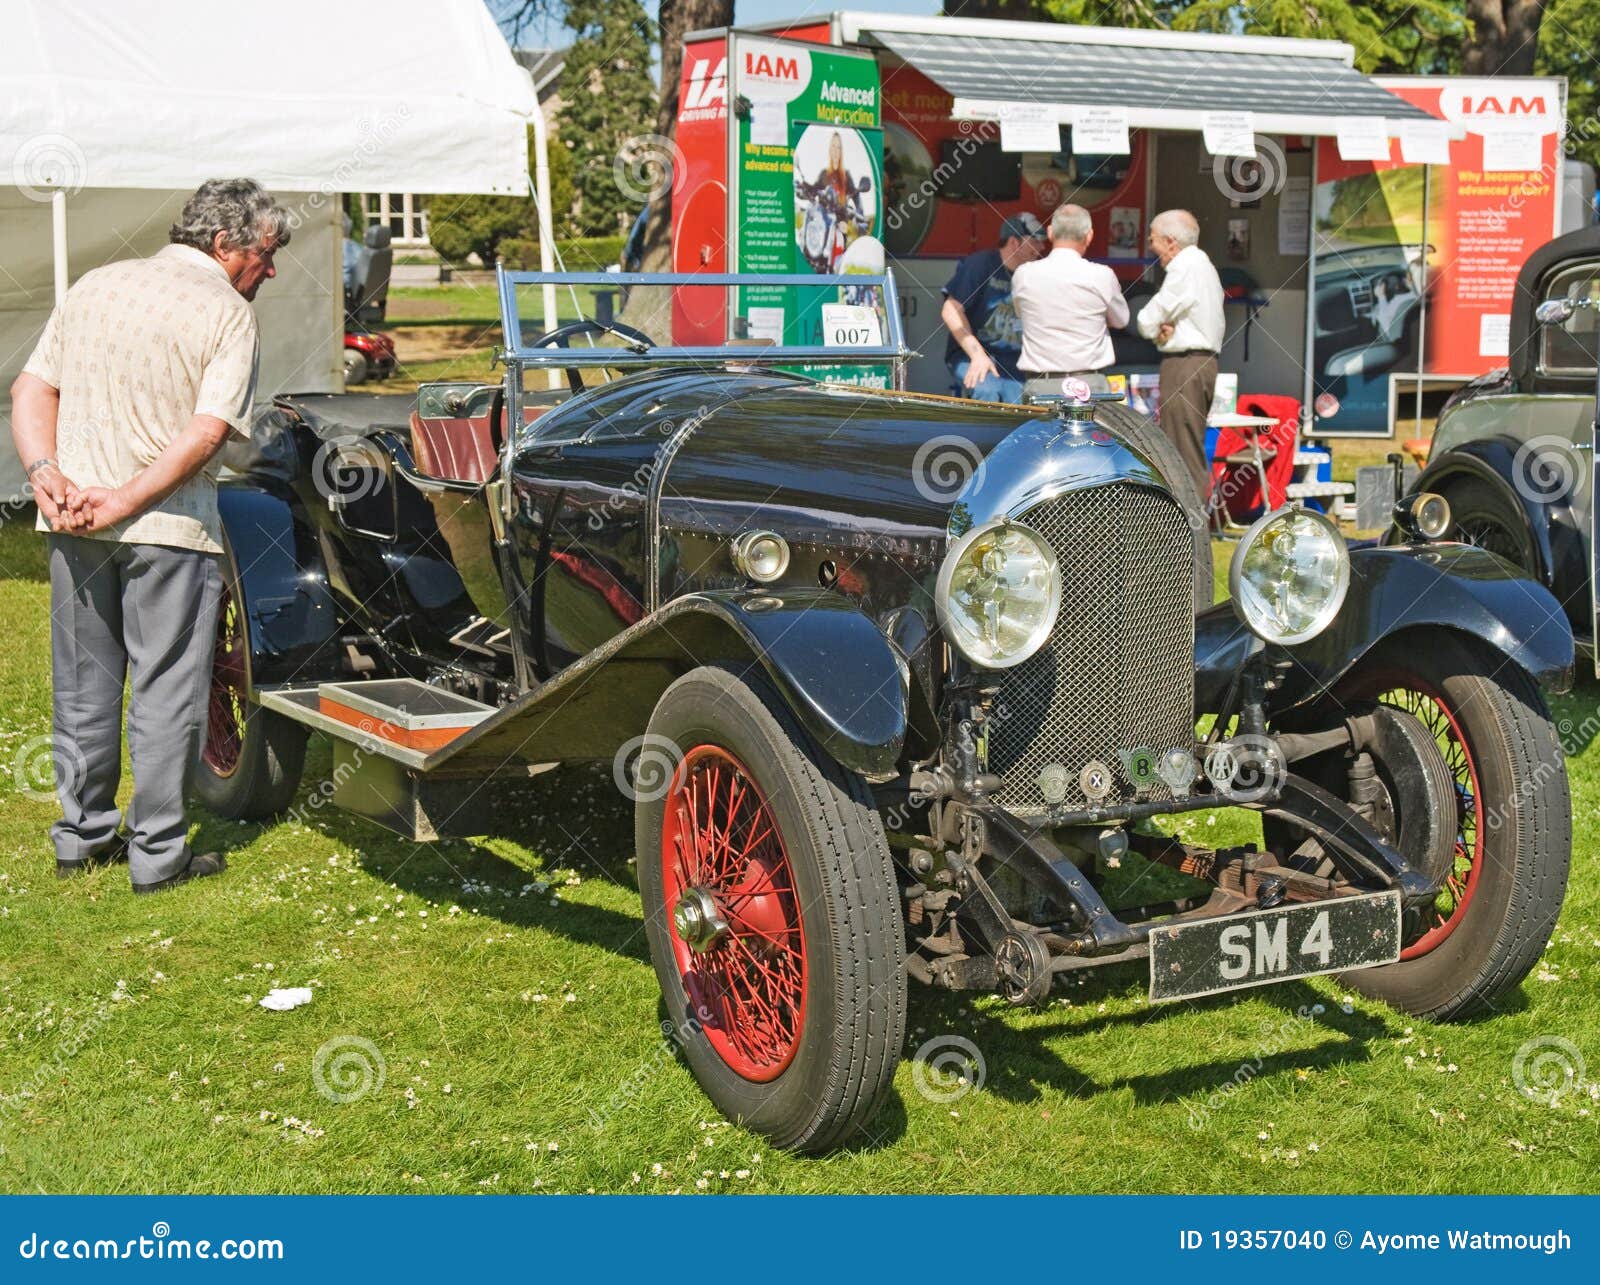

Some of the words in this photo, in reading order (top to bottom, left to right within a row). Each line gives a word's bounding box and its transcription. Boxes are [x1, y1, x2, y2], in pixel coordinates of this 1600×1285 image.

[745, 53, 799, 80] IAM
[820, 80, 875, 107] Advanced
[1462, 96, 1546, 115] IAM
[1458, 171, 1481, 183] Why
[1484, 172, 1525, 182] become
[1458, 185, 1509, 196] advanced
[835, 328, 870, 344] 007
[1219, 918, 1288, 980] SM
[1301, 911, 1334, 964] 4
